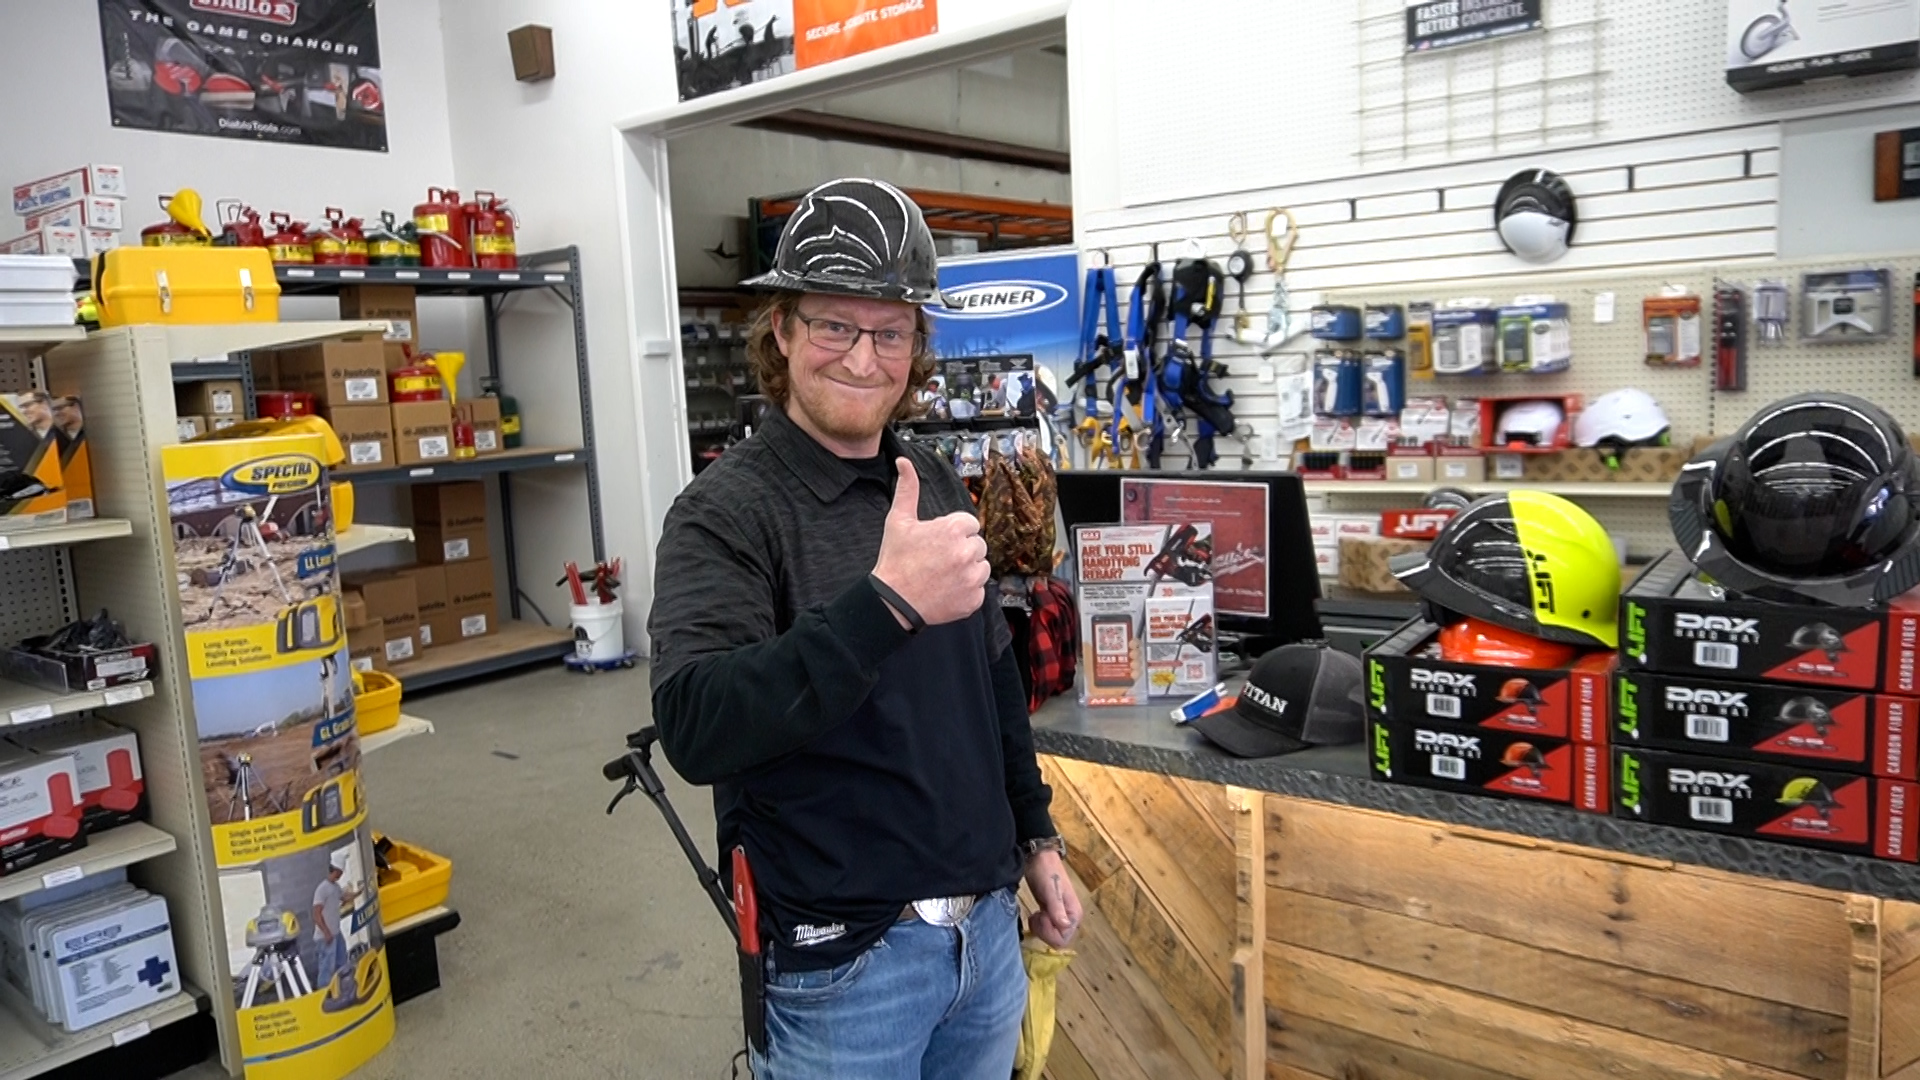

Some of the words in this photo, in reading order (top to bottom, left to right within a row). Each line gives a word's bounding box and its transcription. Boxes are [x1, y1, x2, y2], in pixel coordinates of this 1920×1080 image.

[1416, 1, 1460, 21] FASTER
[129, 9, 174, 27] THE
[186, 21, 249, 40] GAME
[260, 32, 360, 55] CHANGER
[805, 21, 841, 41] SECURE
[1416, 15, 1460, 36] BETTER
[251, 462, 312, 481] SPECTRA
[1394, 513, 1449, 534] LIFT
[1081, 531, 1100, 540] MAX
[1082, 545, 1101, 556] ARE
[1104, 544, 1125, 555] YOU
[1127, 543, 1155, 555] STILL
[1082, 556, 1141, 567] HANDTYING
[1082, 567, 1124, 579] REBAR?
[418, 600, 446, 612] ustrite
[383, 612, 415, 625] ustrite
[1674, 612, 1760, 634] DAX
[1625, 601, 1648, 665] LIFT
[1673, 629, 1718, 641] HARD
[1728, 632, 1760, 645] HAT
[1369, 658, 1388, 714] LIFT
[1410, 668, 1477, 688] DAX
[1243, 680, 1289, 714] TITAN
[1664, 686, 1748, 707] DAX
[1618, 677, 1639, 740] LIFT
[1664, 701, 1709, 714] HARD
[1719, 704, 1749, 719] HAT
[1415, 729, 1481, 749] DAX
[1374, 722, 1392, 778] LIFT
[1621, 753, 1642, 815] LIFT
[1667, 768, 1751, 789] DAX
[1668, 783, 1712, 796] HARD
[1723, 785, 1752, 799] HAT
[793, 922, 848, 942] Milwaukee
